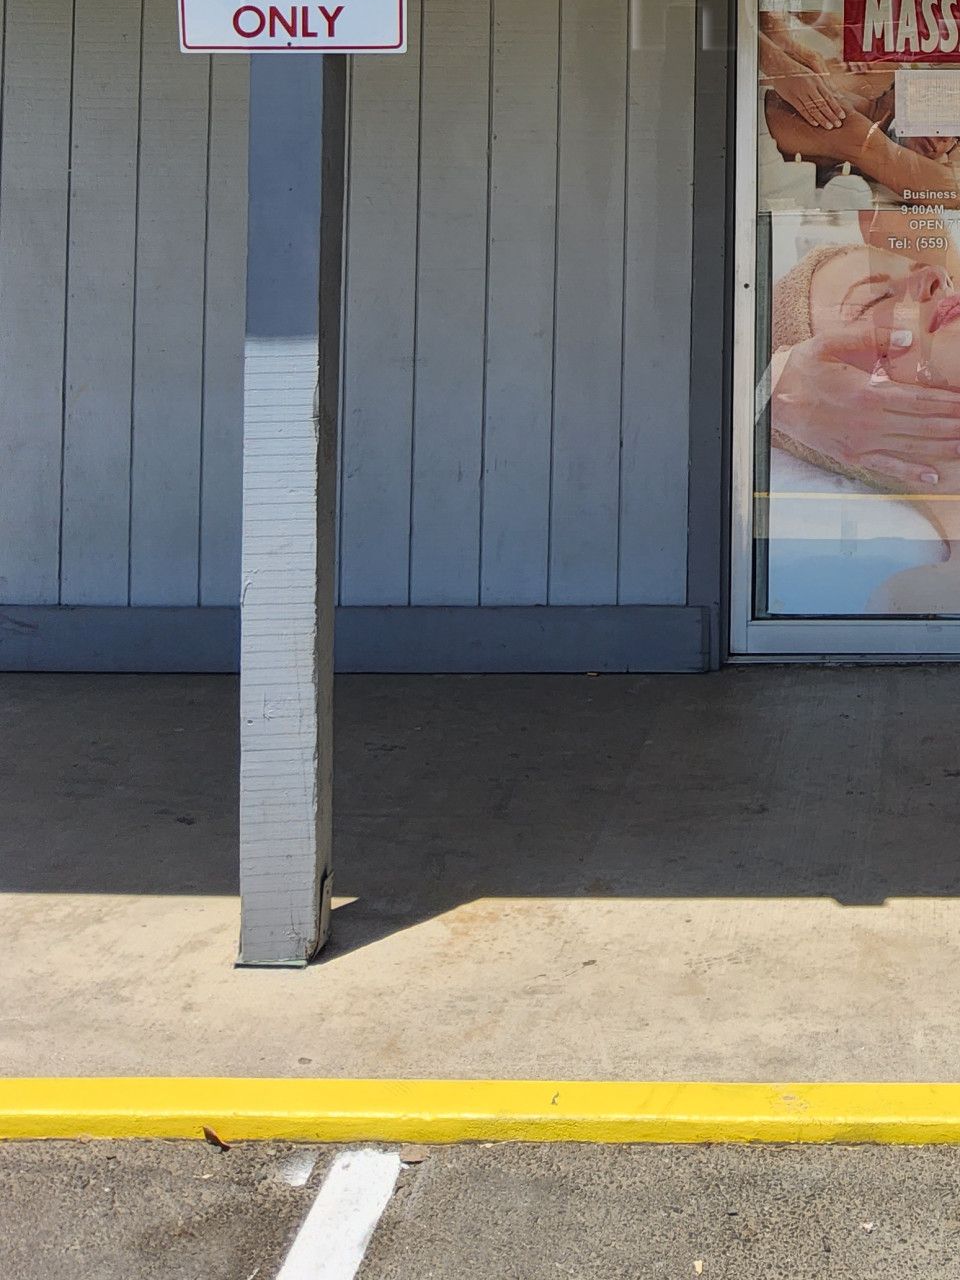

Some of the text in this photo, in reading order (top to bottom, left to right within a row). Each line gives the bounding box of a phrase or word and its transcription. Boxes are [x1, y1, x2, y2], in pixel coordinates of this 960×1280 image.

[232, 5, 345, 38] ONLY
[903, 189, 957, 200] Business
[909, 219, 944, 230] OPEN
[888, 238, 948, 251] Tel: (559)
